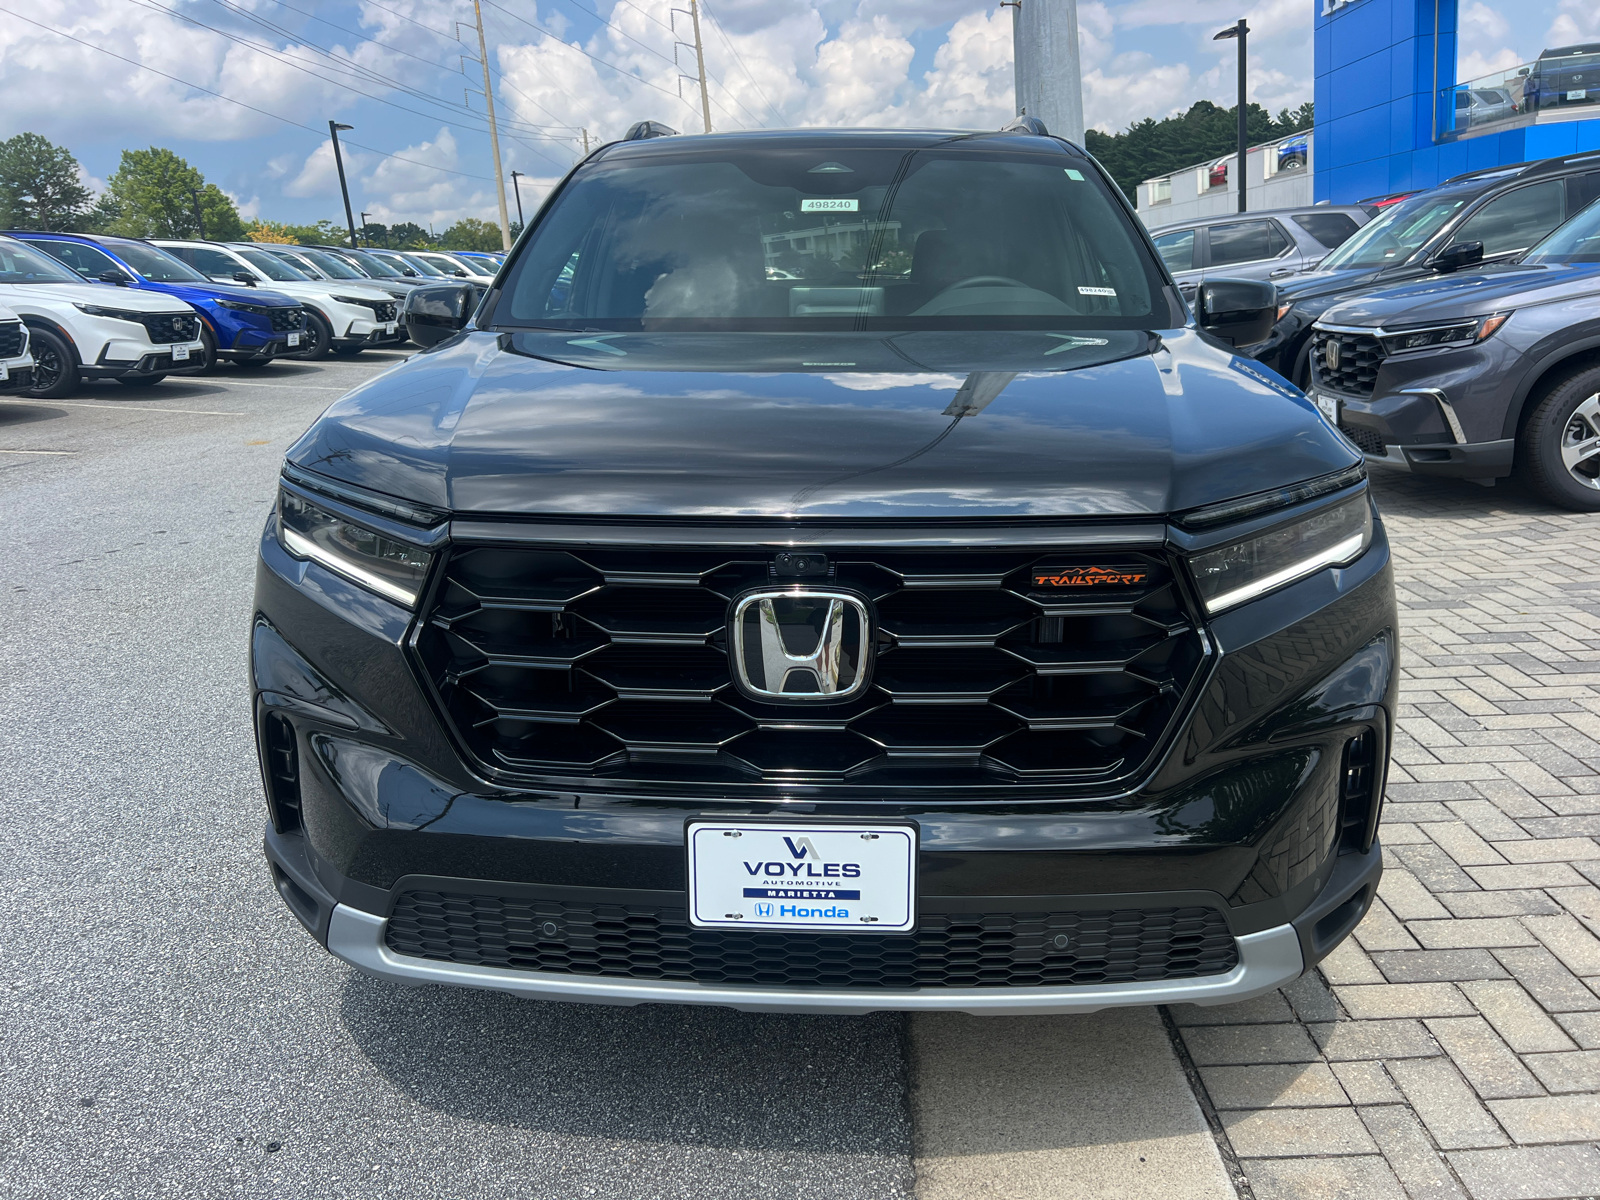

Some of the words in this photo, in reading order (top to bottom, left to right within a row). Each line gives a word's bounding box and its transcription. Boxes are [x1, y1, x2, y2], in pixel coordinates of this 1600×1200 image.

[807, 201, 851, 209] 498240
[1035, 574, 1146, 586] TRAILSPORT
[743, 861, 861, 878] VOYLES
[767, 889, 836, 898] MARIETTA
[780, 904, 849, 918] Honda
